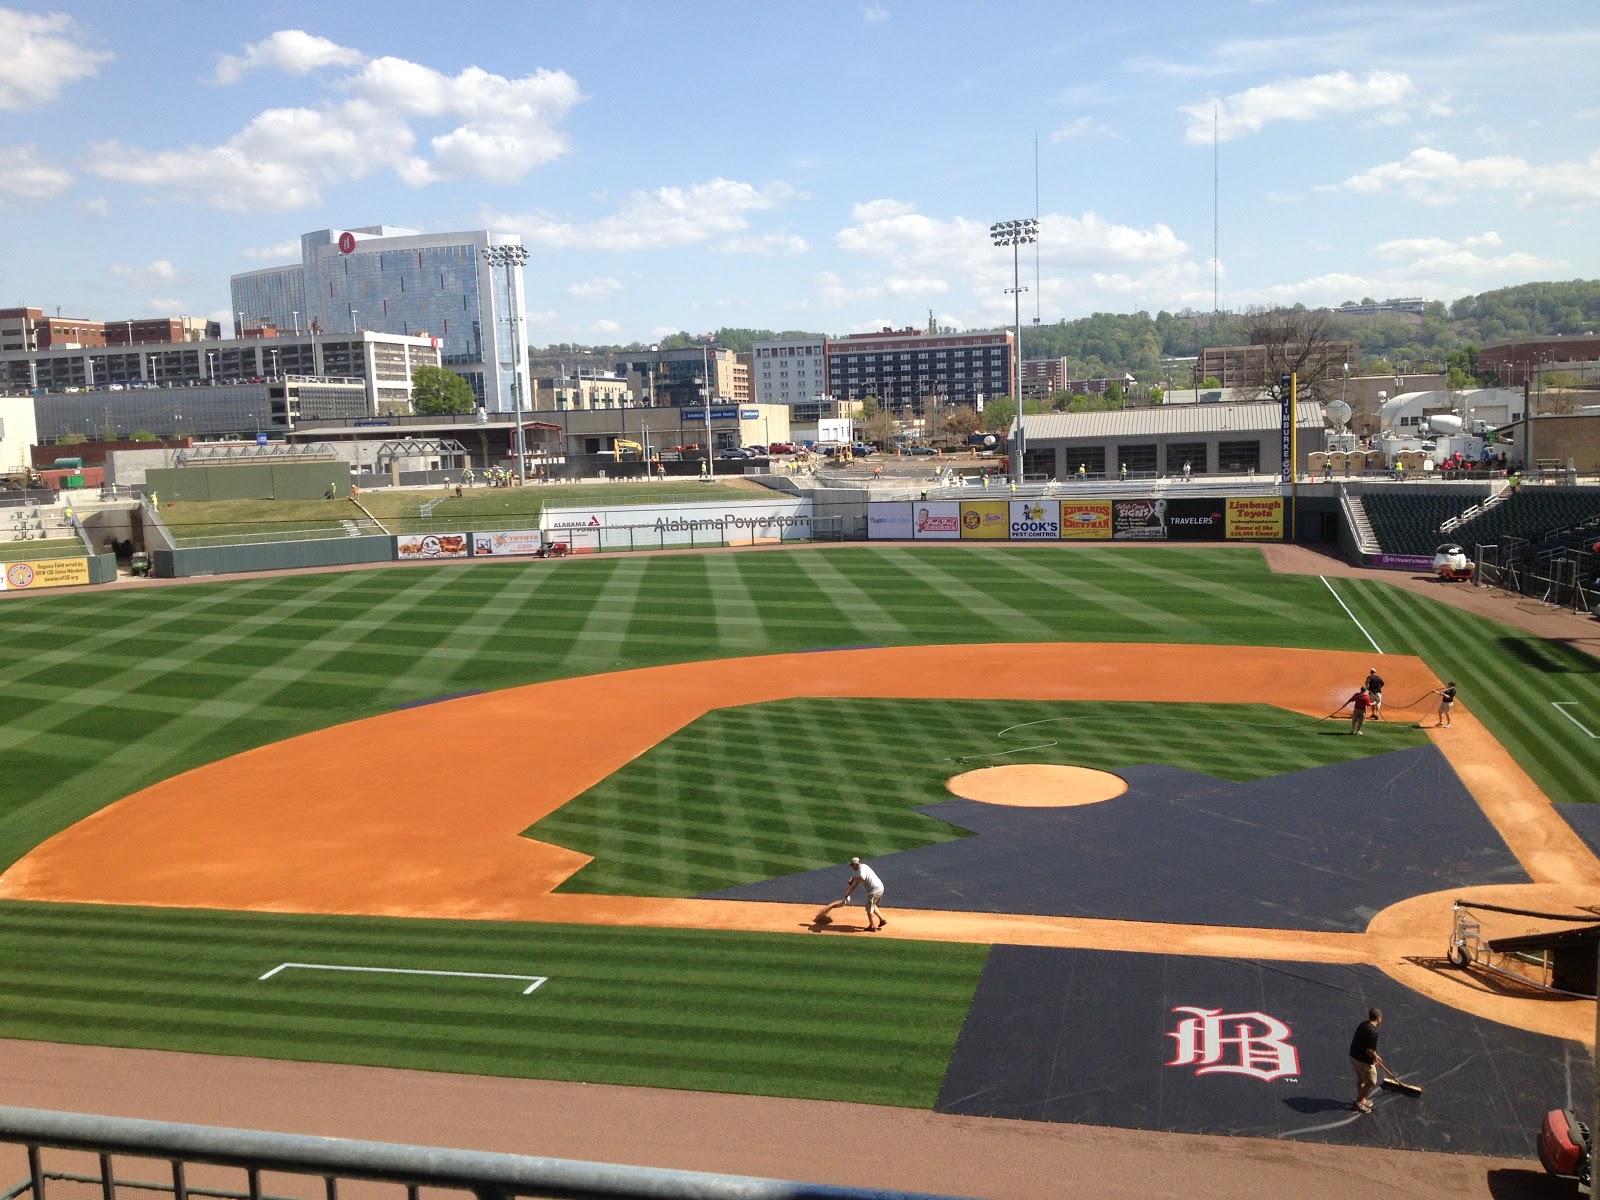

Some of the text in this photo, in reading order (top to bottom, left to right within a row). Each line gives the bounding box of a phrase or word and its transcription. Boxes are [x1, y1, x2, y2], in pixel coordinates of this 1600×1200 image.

[1229, 501, 1281, 510] Limbaugh
[1119, 508, 1149, 517] SIGNS
[1237, 509, 1273, 518] Toyota
[654, 514, 809, 533] AlabamaPower.com
[1170, 517, 1214, 525] TRAVELERS
[1011, 522, 1058, 532] COOK'S
